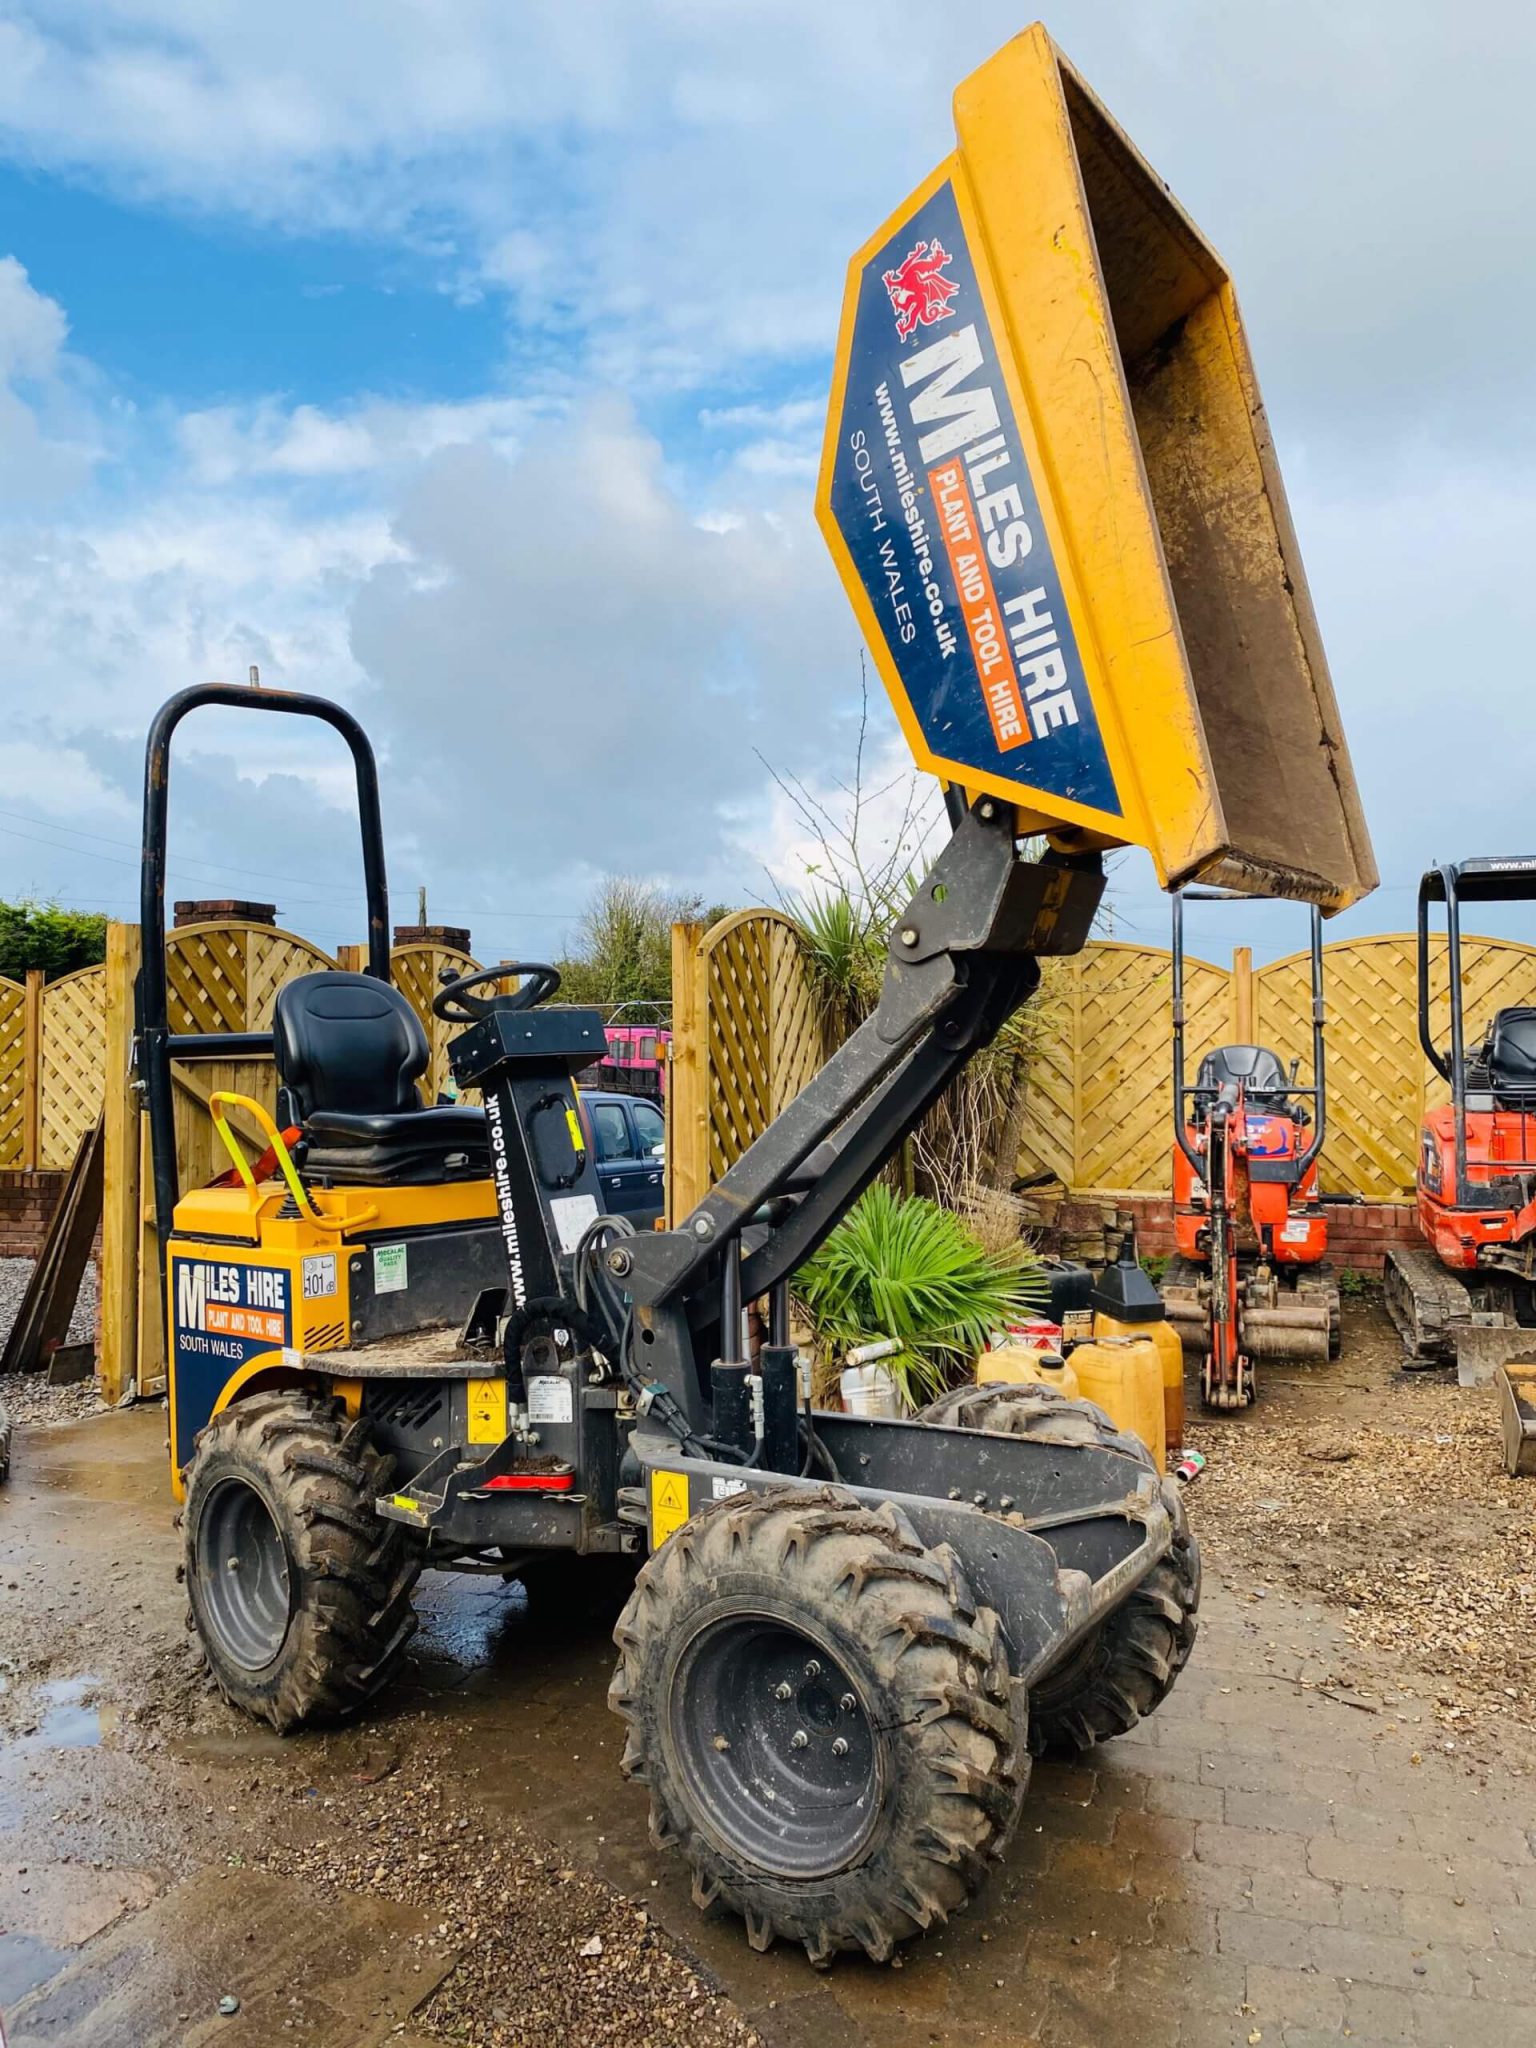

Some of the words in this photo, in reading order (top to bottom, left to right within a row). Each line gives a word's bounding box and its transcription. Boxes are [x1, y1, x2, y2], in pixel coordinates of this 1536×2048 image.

[851, 429, 887, 533] SOUTH
[878, 538, 916, 645] WALES
[875, 381, 957, 659] www.mileshire.co.uk
[900, 323, 1032, 568] MILES
[1003, 586, 1079, 739] HIRE
[935, 468, 968, 543] PLANT
[956, 552, 986, 603] AND
[970, 607, 1004, 675] TOOL
[988, 680, 1021, 741] HIRE
[179, 1264, 240, 1331] MILES
[246, 1270, 285, 1310] HIRE
[306, 1273, 323, 1295] 101
[180, 1334, 209, 1353] SOUTH
[211, 1338, 244, 1360] WALES
[207, 1309, 229, 1329] PLANT
[231, 1312, 246, 1332] AND
[247, 1314, 265, 1335] TOOL
[265, 1317, 282, 1338] HIRE
